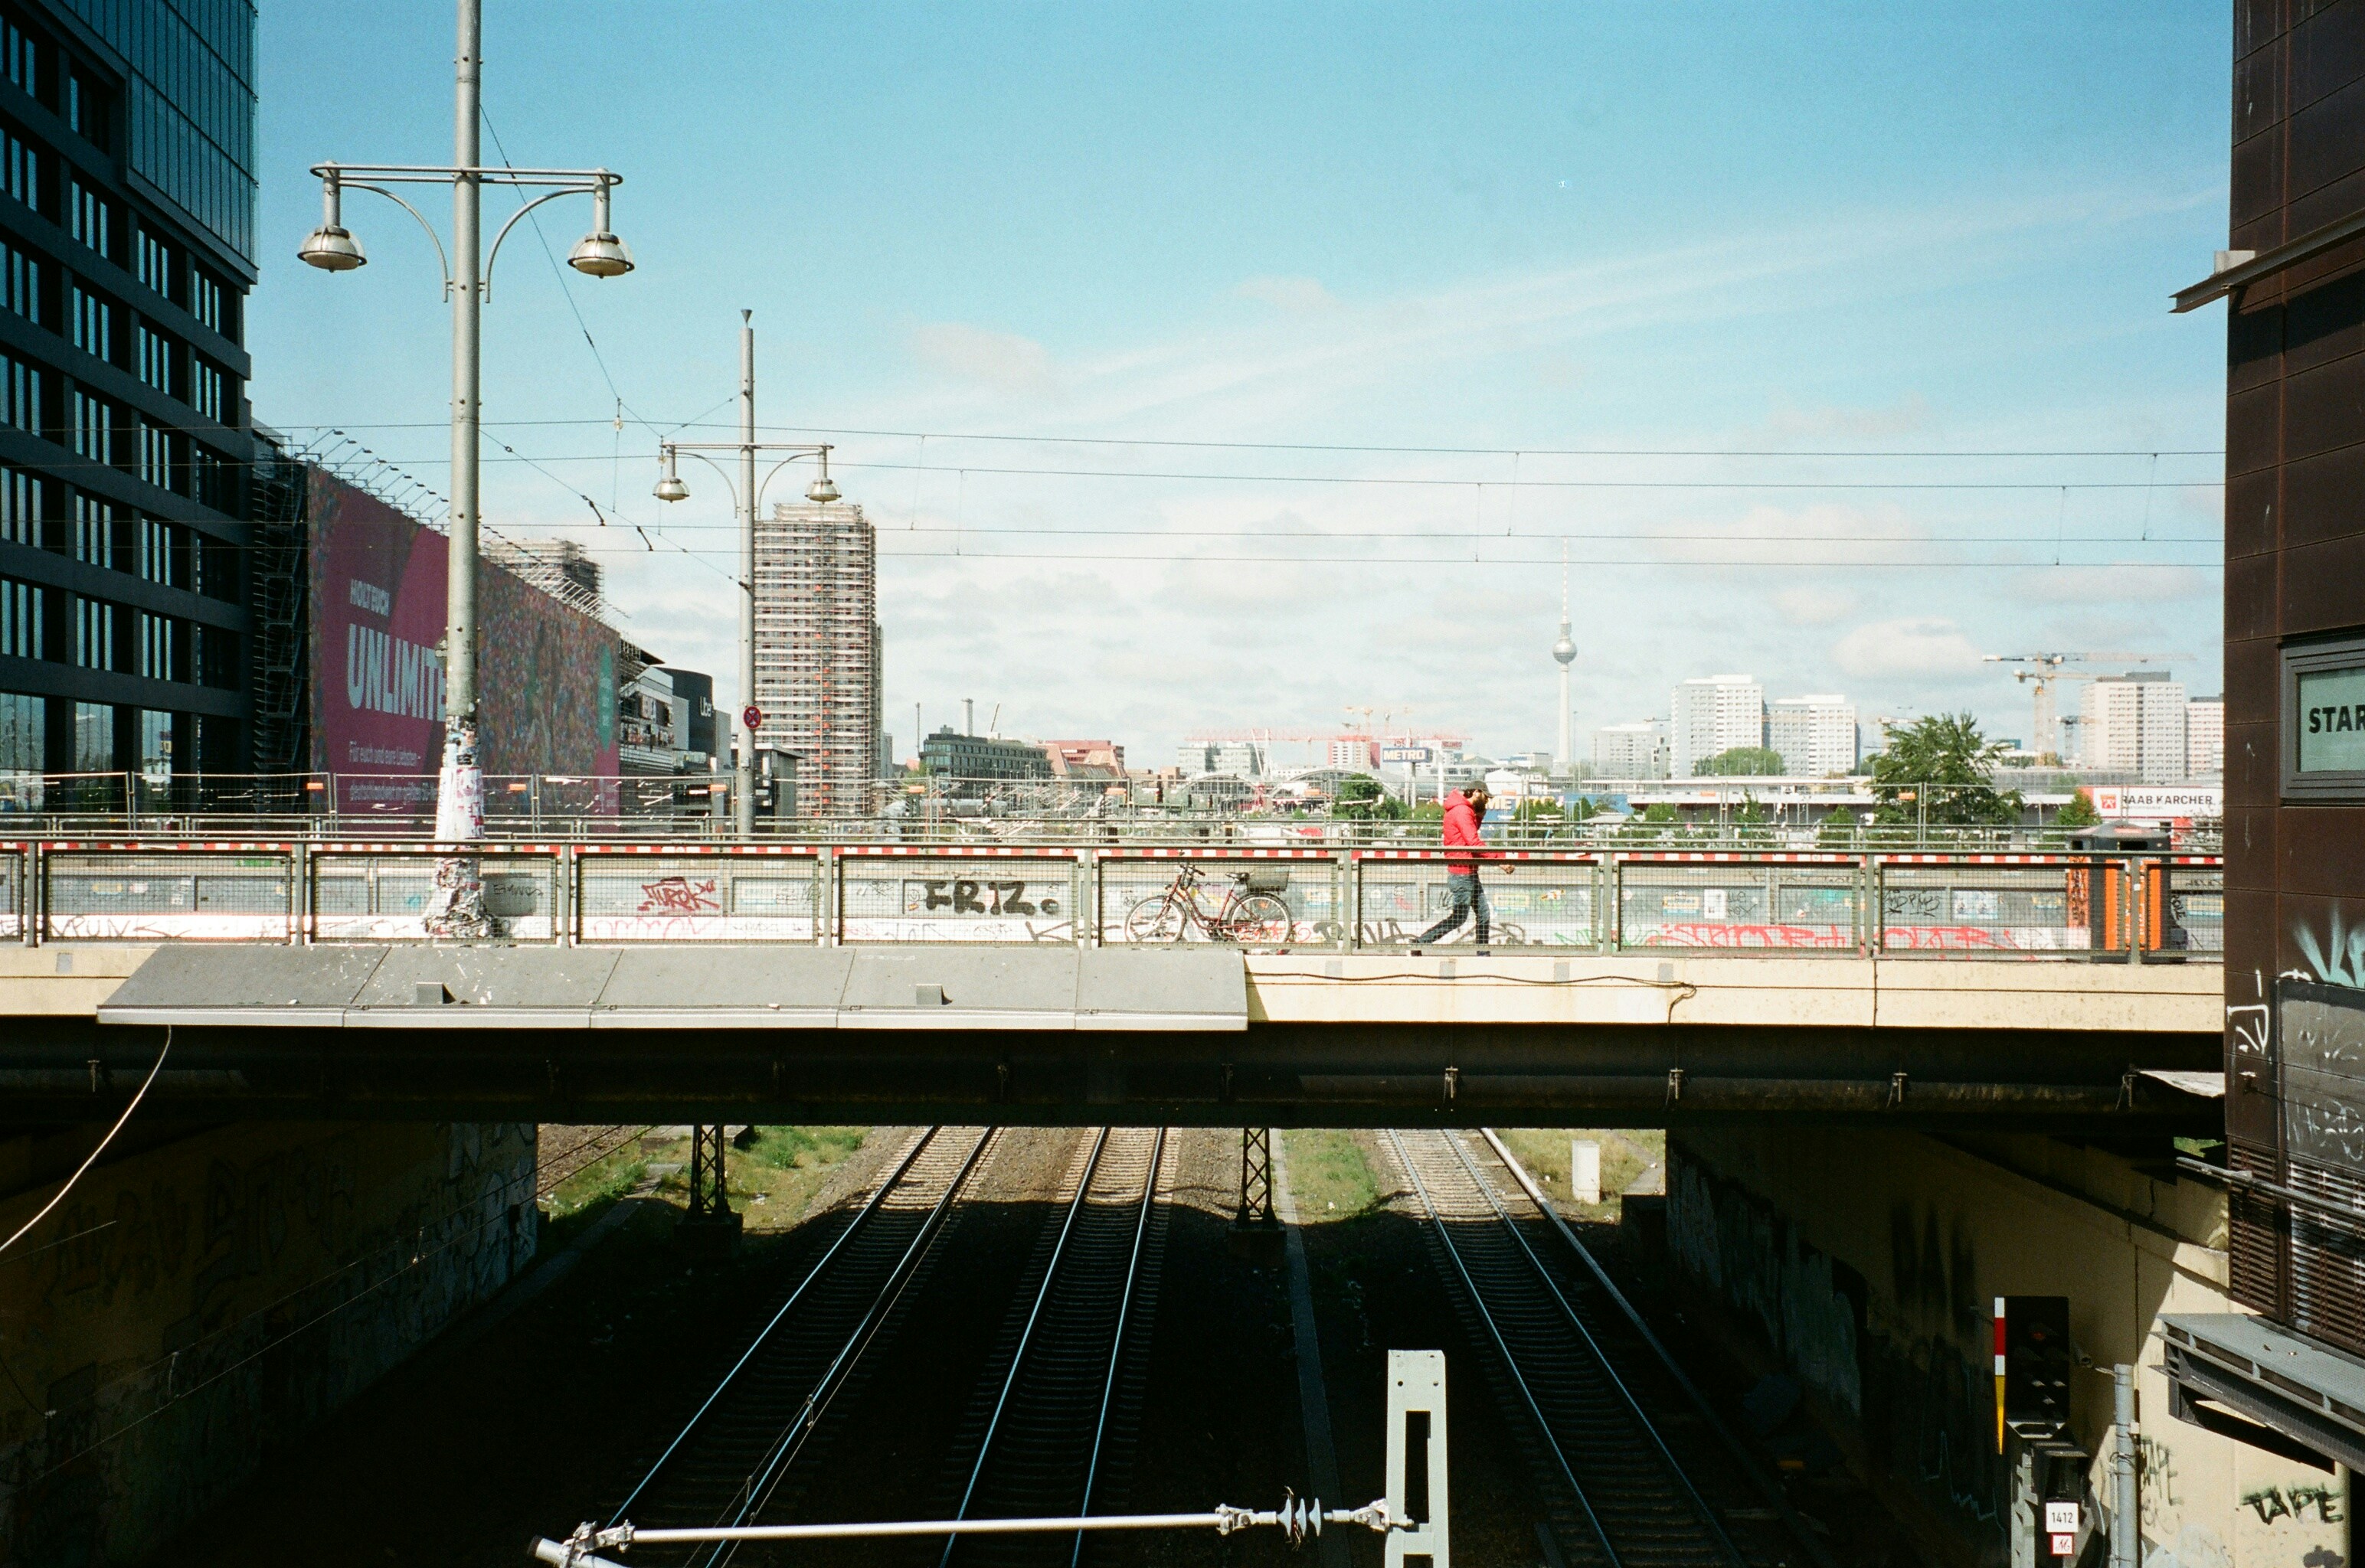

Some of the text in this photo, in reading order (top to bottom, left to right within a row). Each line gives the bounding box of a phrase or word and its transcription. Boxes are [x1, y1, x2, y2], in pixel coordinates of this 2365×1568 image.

[348, 623, 447, 721] UNLIMITE
[1383, 750, 1423, 760] METRO
[2121, 795, 2213, 805] RAAB KARCHER
[2240, 1483, 2344, 1526] TAPE
[2052, 1512, 2073, 1524] 1412
